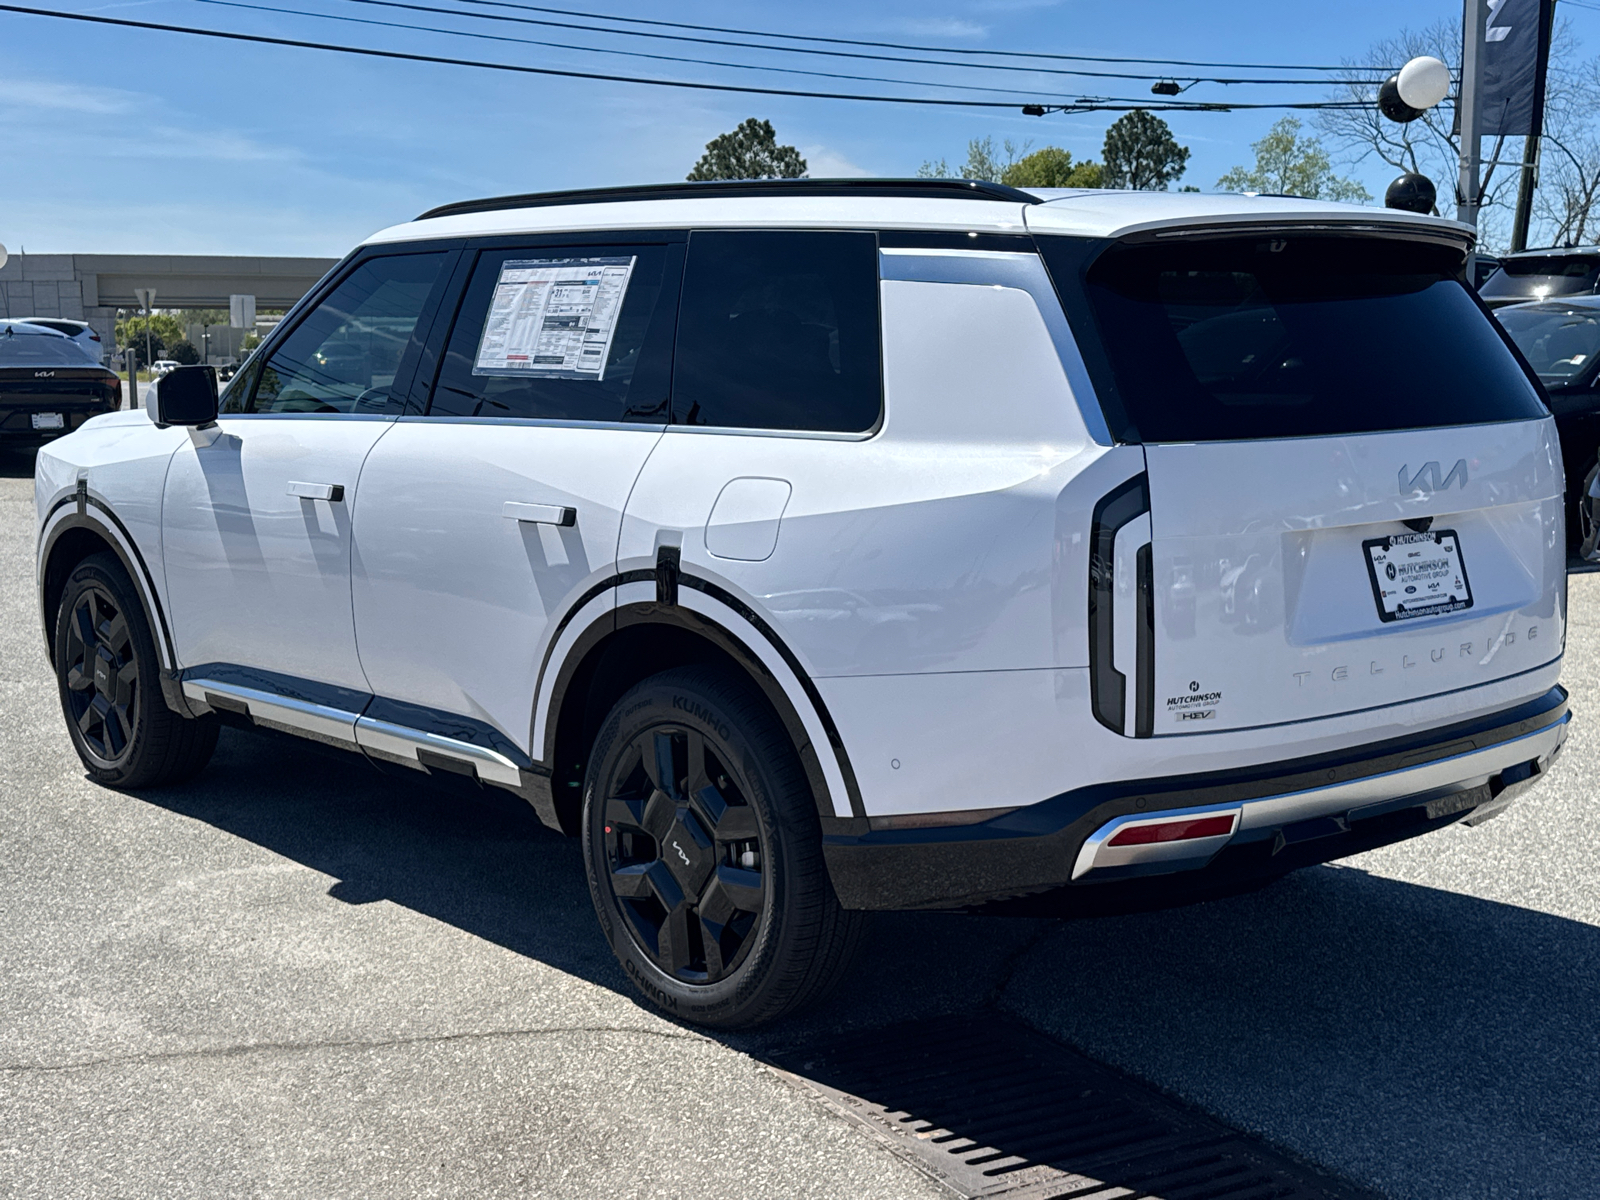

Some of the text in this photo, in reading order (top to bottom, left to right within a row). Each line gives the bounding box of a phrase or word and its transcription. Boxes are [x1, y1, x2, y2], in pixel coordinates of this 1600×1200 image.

[1398, 459, 1468, 496] KIA
[1397, 532, 1435, 545] HUTCHINSON
[1398, 560, 1449, 576] HUTCHINSON
[1293, 626, 1538, 687] TELLURIDE
[1167, 691, 1222, 705] HUTCHINSON
[625, 698, 652, 717] OUTSIDE
[1168, 703, 1201, 711] AUTOMOTIVE
[1183, 711, 1211, 720] HEV
[672, 695, 731, 741] KUMHO
[625, 958, 678, 1010] KUMHO
